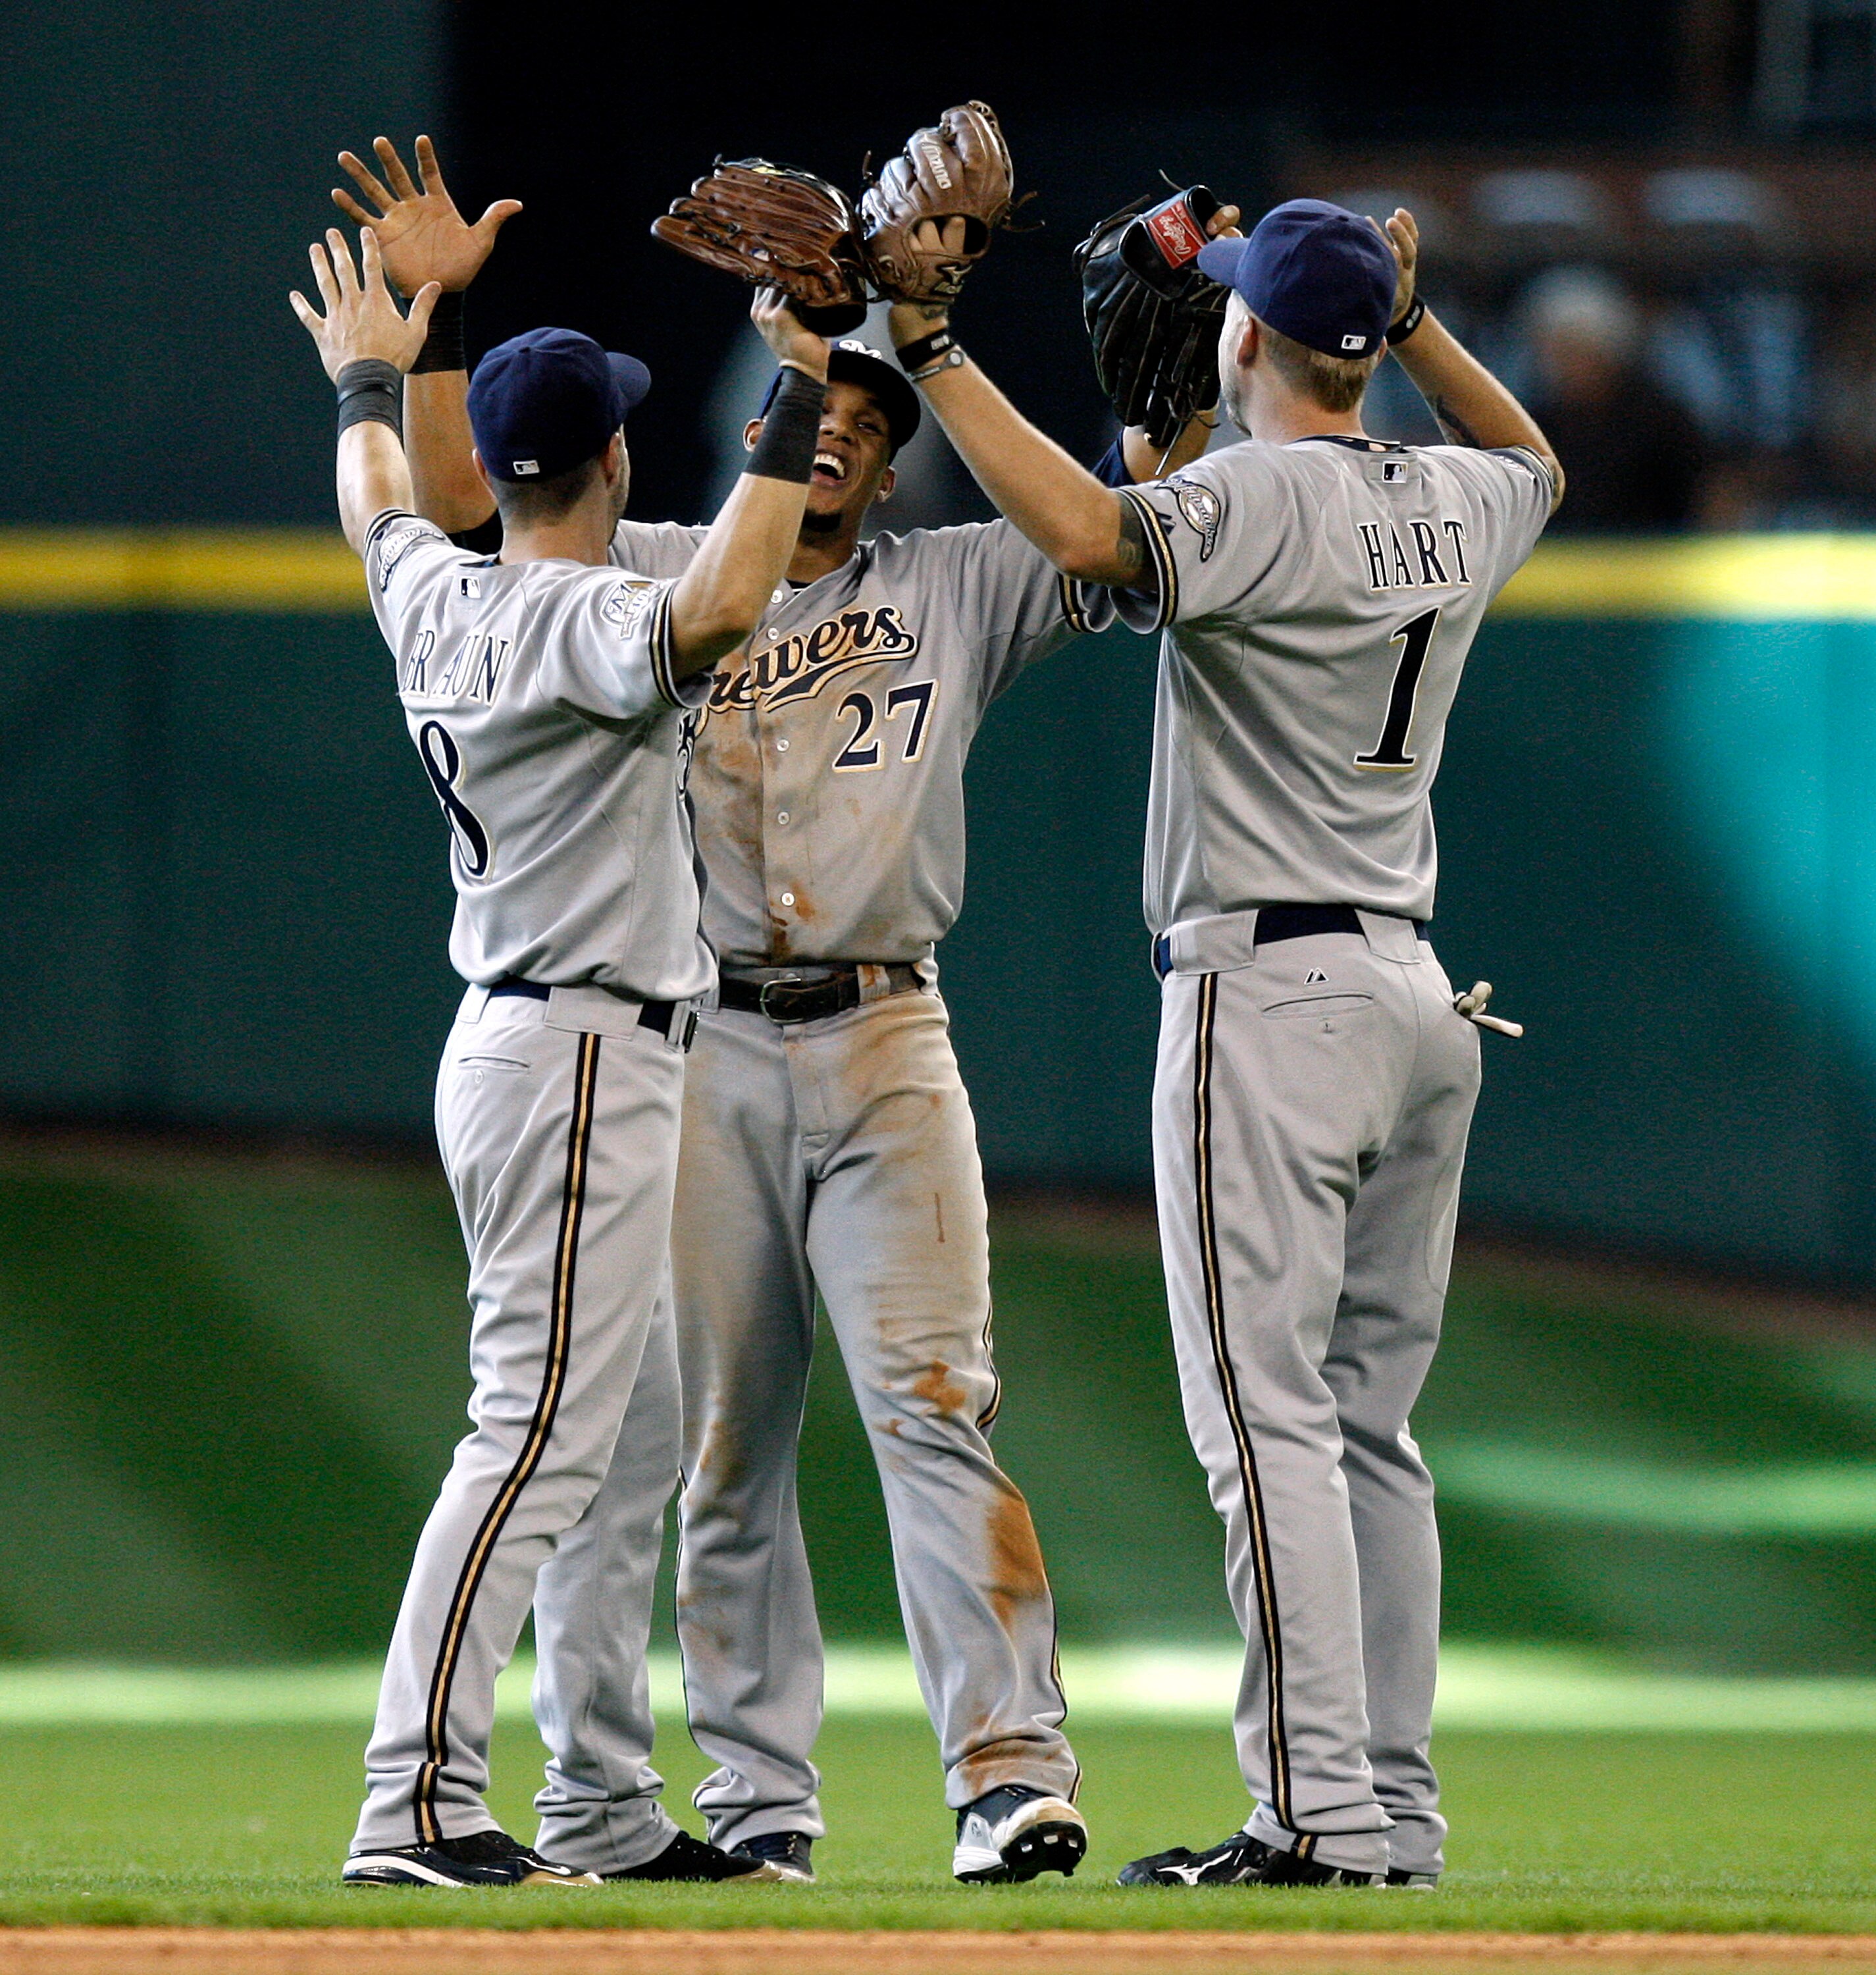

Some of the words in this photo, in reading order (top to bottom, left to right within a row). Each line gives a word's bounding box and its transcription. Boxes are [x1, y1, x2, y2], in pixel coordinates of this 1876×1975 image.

[1357, 517, 1473, 592] HART
[696, 605, 918, 733] rewers
[833, 678, 939, 773] 27
[1353, 604, 1443, 772] 1
[419, 719, 495, 881] 8
